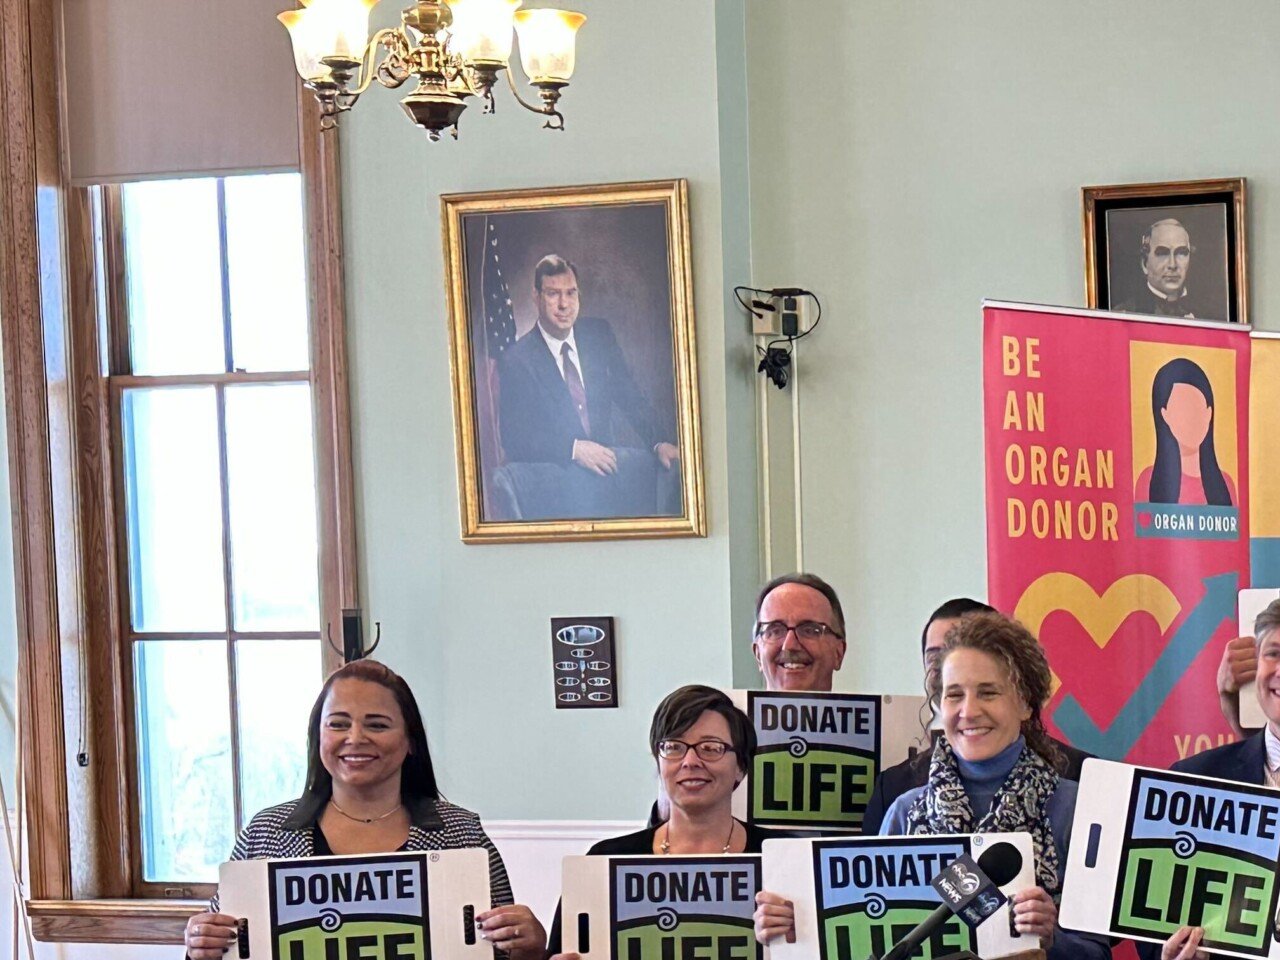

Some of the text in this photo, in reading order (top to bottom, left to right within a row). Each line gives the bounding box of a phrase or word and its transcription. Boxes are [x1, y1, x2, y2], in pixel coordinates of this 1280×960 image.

[1002, 335, 1041, 378] BE
[1003, 390, 1045, 432] AN
[1005, 443, 1114, 488] ORGAN
[1007, 498, 1119, 541] DONOR
[1154, 513, 1237, 532] ORGAN DONOR
[761, 704, 870, 735] DONATE
[762, 761, 868, 813] LIFE
[1144, 787, 1279, 840] DONATE
[284, 868, 415, 906] DONATE
[625, 870, 749, 903] DONATE
[939, 878, 962, 903] NEWS
[1130, 857, 1266, 937] LIFE
